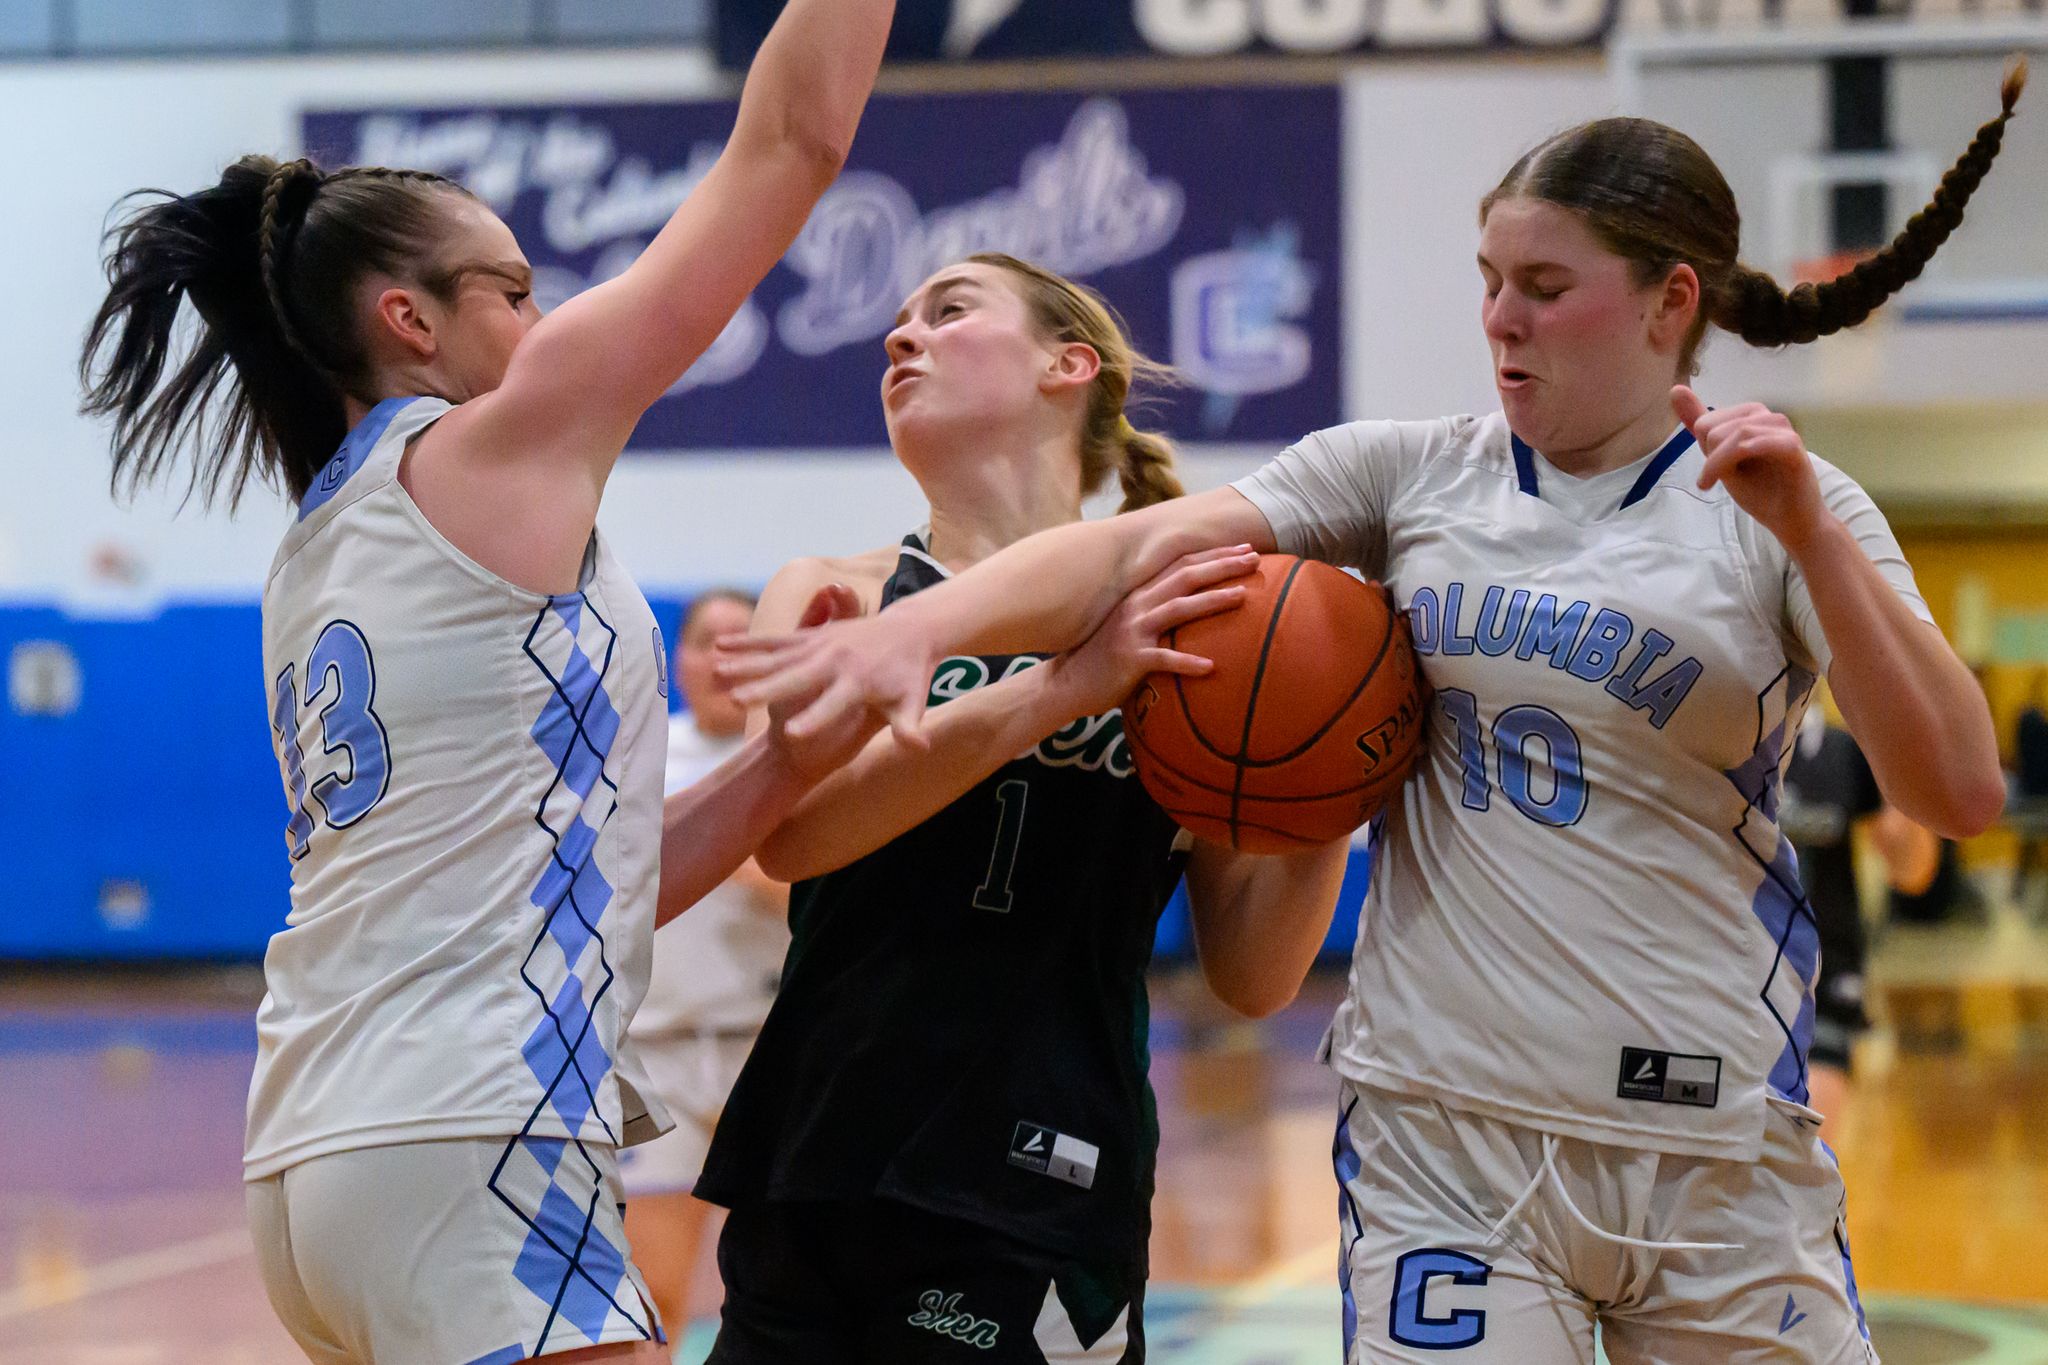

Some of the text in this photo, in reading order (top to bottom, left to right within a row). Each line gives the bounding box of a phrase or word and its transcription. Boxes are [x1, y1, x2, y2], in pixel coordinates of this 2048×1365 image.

[1409, 582, 1704, 730] OLUMBIA
[272, 618, 392, 861] 13
[1436, 686, 1590, 827] 10
[972, 779, 1028, 913] 1
[1681, 1085, 1698, 1099] M
[1069, 1164, 1077, 1178] L
[907, 1289, 1000, 1348] Shen
[1389, 1247, 1494, 1350] C
